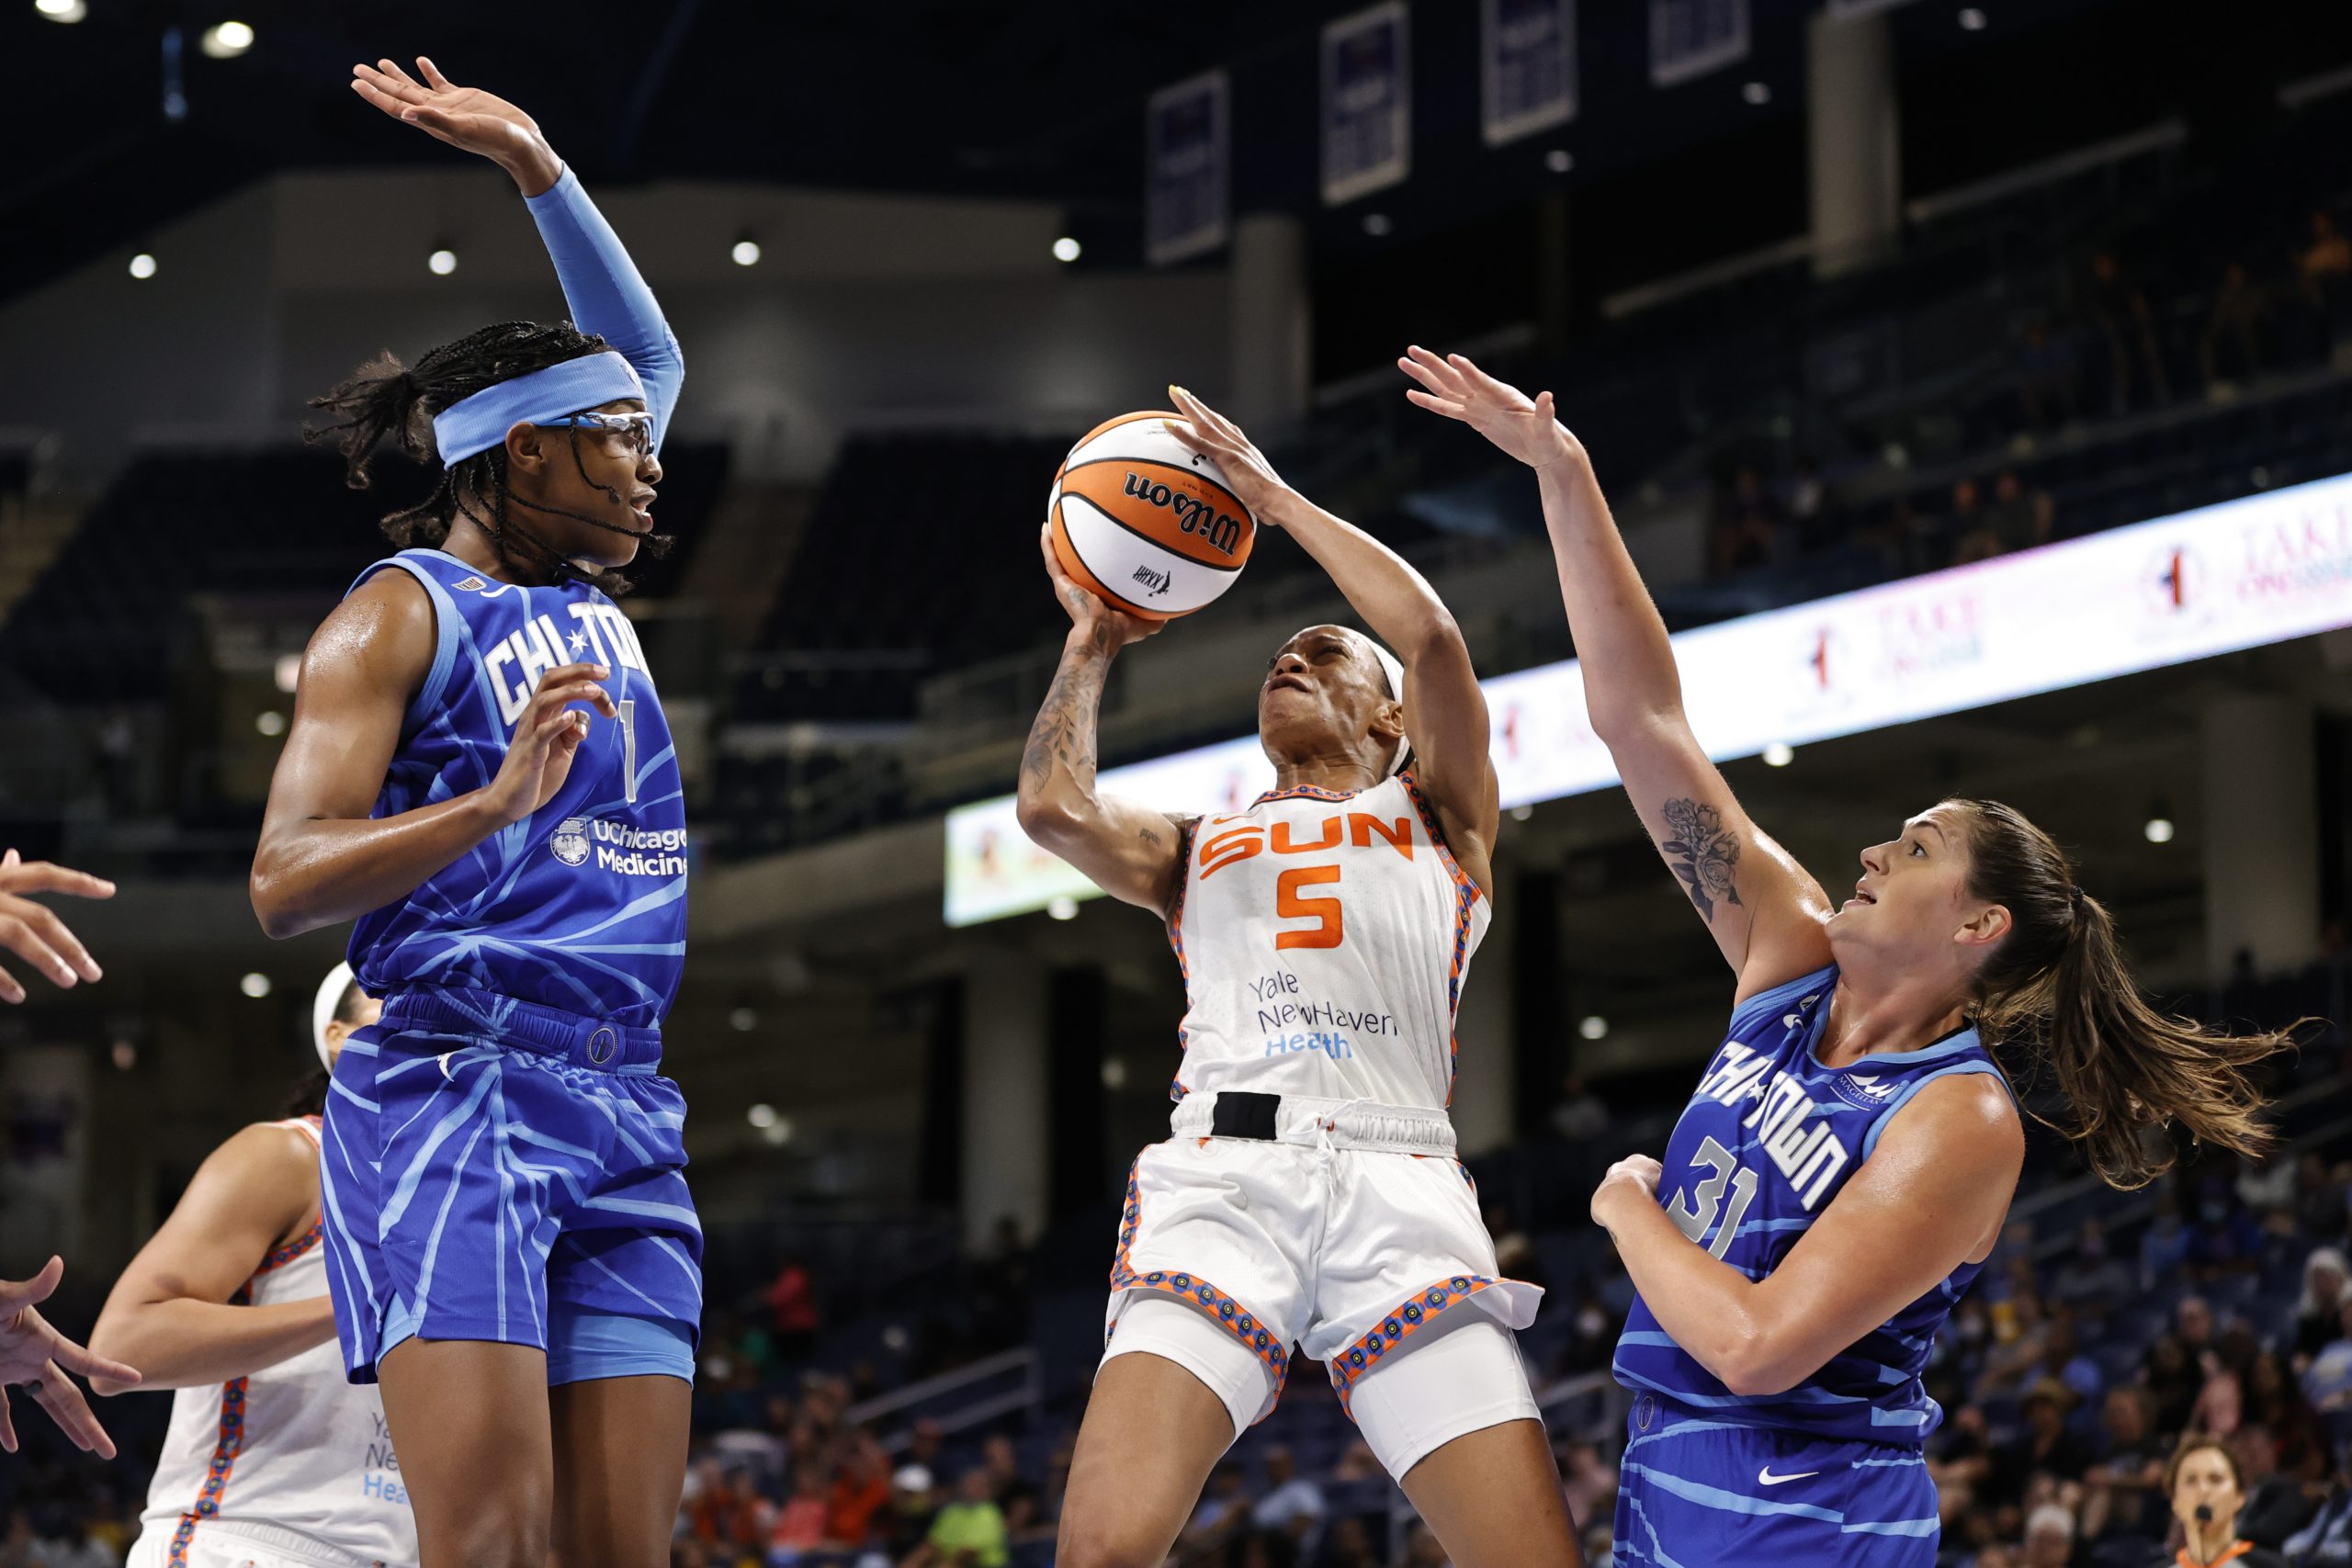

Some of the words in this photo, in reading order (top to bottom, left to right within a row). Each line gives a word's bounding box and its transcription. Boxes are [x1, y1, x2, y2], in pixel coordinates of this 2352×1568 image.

[1124, 471, 1240, 556] Wilson
[618, 700, 637, 804] 1
[594, 819, 687, 851] UChicago
[1199, 812, 1414, 881] SUN
[1275, 864, 1343, 951] 5
[1249, 971, 1299, 1003] Yale
[1265, 1032, 1352, 1060] Heath
[1666, 1135, 1758, 1261] 31
[373, 1412, 390, 1439] Ya
[365, 1443, 399, 1472] Ne
[363, 1473, 407, 1504] Hea
